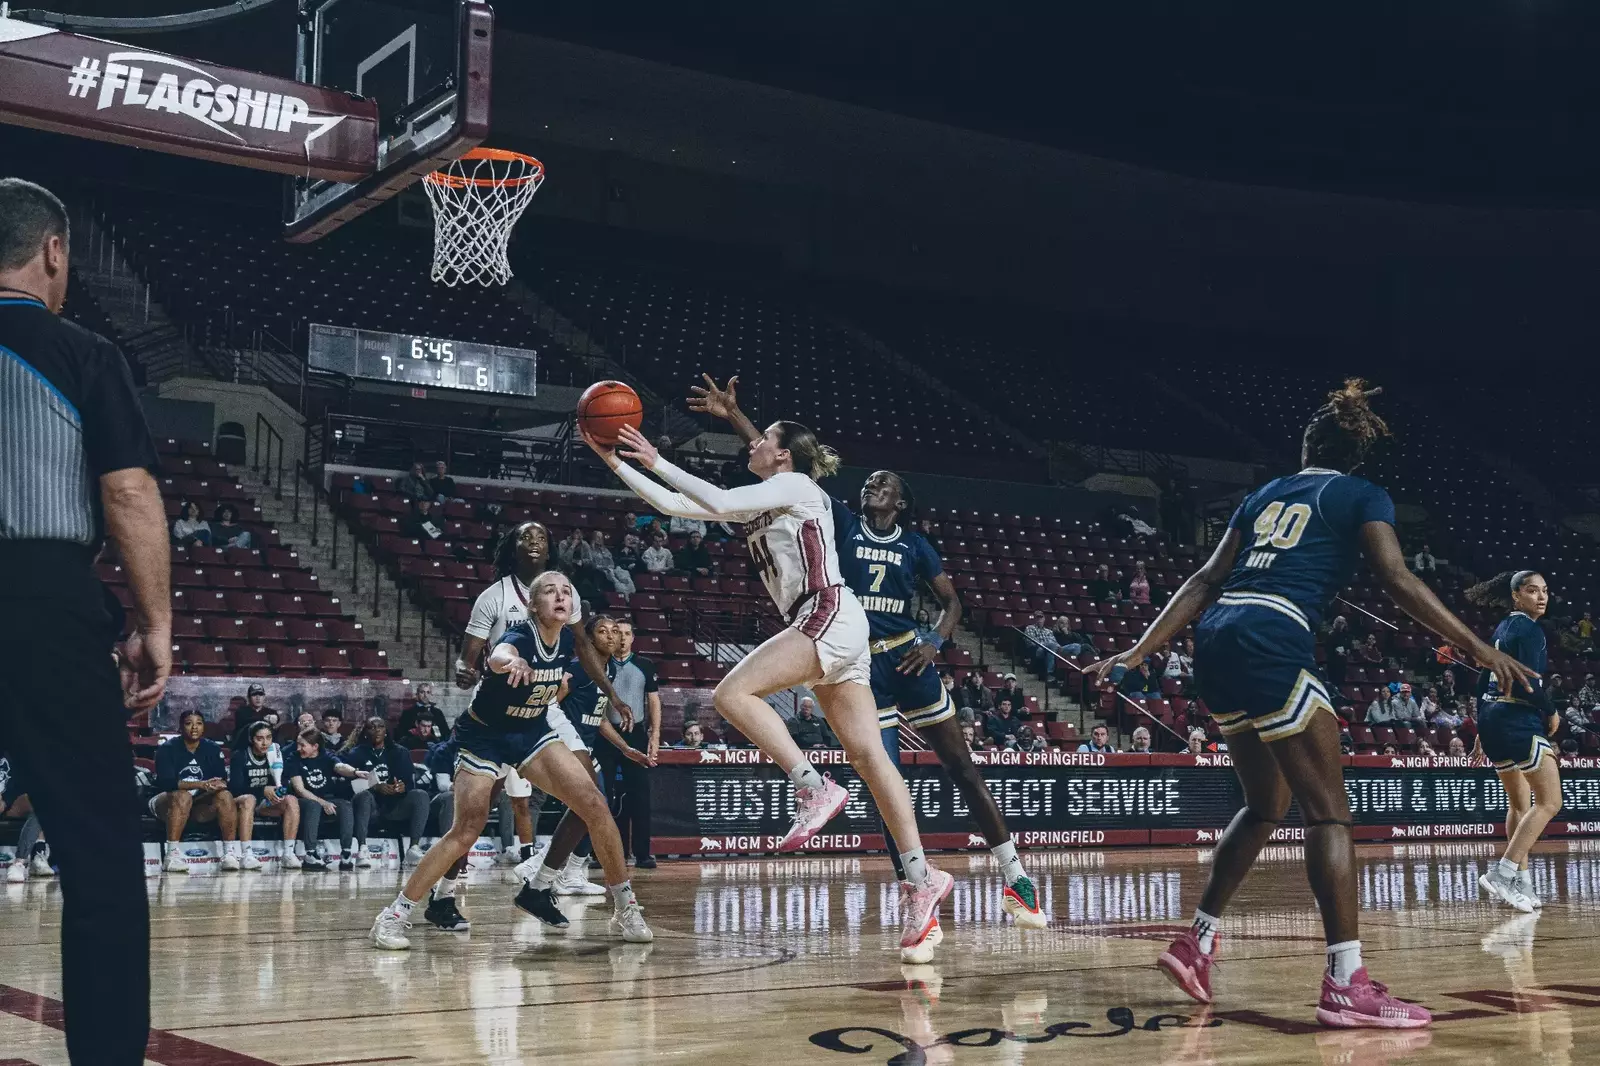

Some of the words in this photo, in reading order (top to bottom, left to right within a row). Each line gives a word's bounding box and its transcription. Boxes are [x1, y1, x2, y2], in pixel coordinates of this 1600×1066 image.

[68, 52, 312, 134] #FLAGSHIP
[411, 339, 454, 362] 6:45
[381, 355, 392, 375] 7
[476, 367, 488, 387] 6
[1253, 501, 1312, 549] 40
[856, 546, 902, 566] GEORGE
[869, 564, 886, 592] 7
[526, 684, 559, 706] 20
[725, 750, 760, 763] MGM
[990, 751, 1020, 765] MGM
[1025, 753, 1105, 766] SPRINGFIELD
[1407, 757, 1429, 768] MGM
[1573, 758, 1594, 768] MGM
[1067, 779, 1180, 815] SERVICE
[1411, 779, 1428, 812] &
[1434, 779, 1477, 812] NYC
[1024, 831, 1105, 845] SPRINGFIELD
[1407, 825, 1431, 837] MGM
[1433, 823, 1495, 836] SPRINGFIELD
[725, 836, 760, 849] MGM
